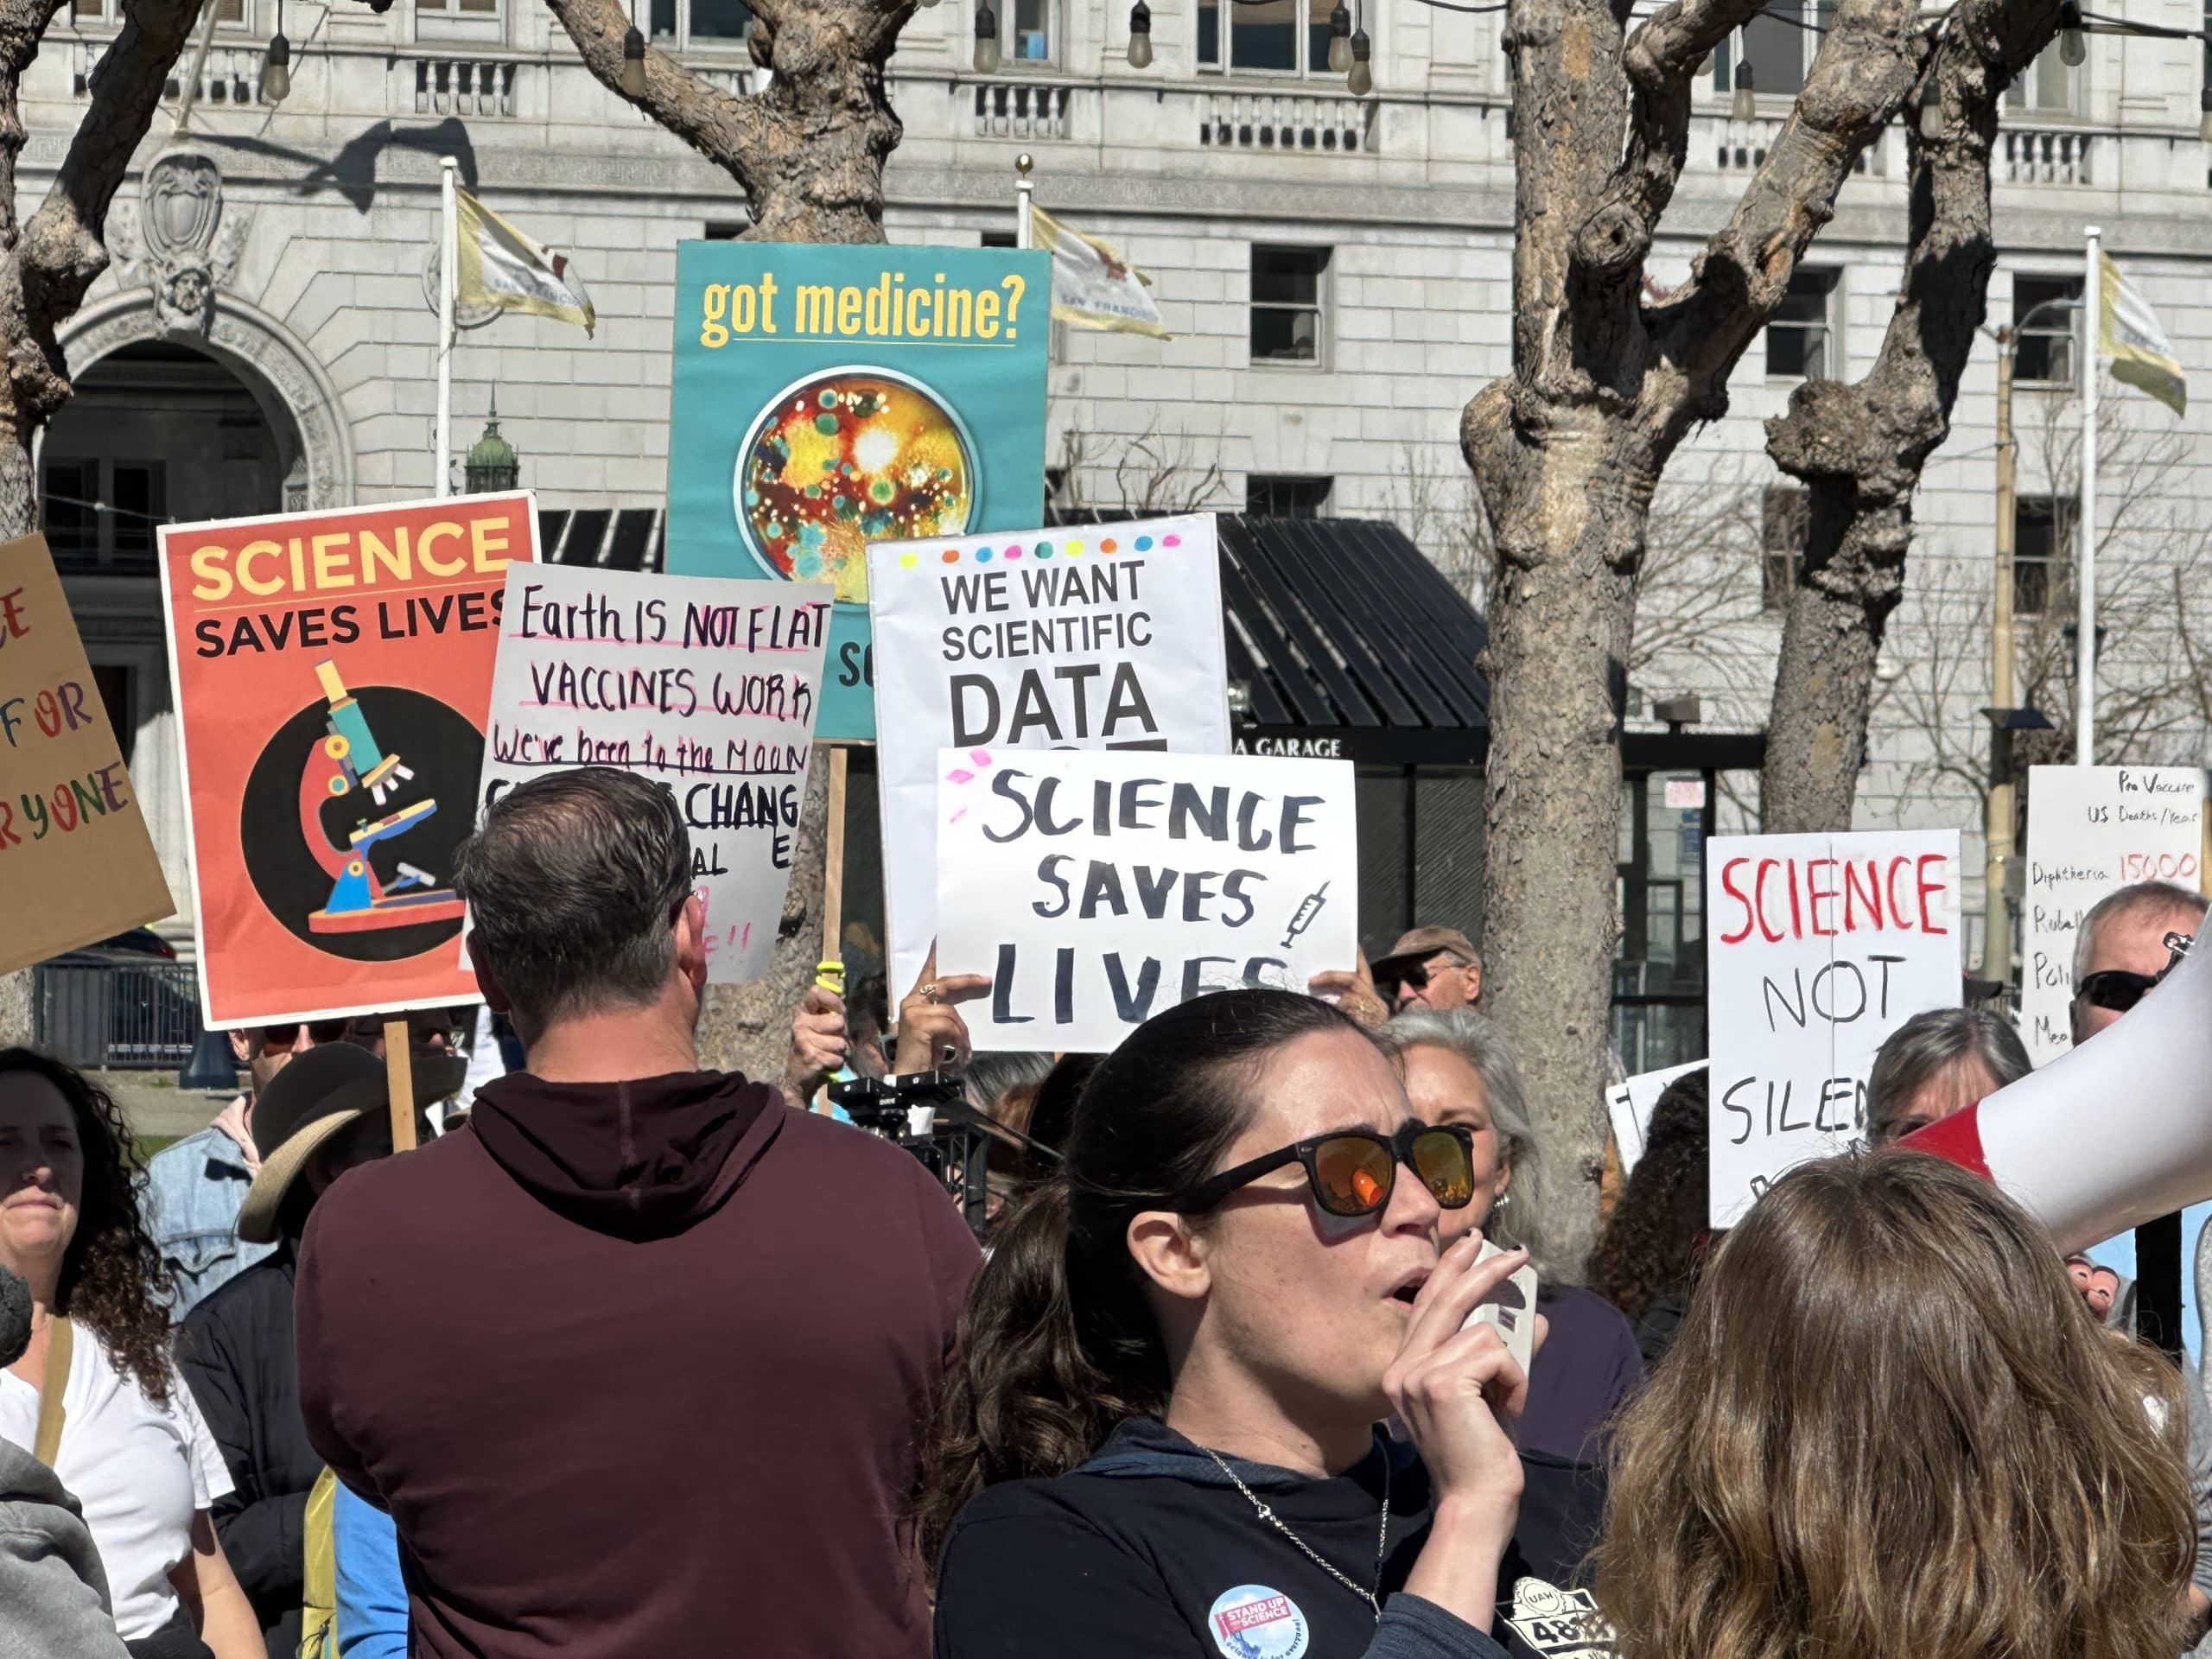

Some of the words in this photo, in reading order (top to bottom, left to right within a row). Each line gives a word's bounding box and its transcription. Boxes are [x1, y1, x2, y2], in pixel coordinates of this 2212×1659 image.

[701, 272, 778, 347] got
[796, 272, 1026, 339] medicine?
[191, 517, 512, 601] SCIENCE
[940, 570, 1009, 615] WE
[1022, 560, 1146, 607] WANT
[194, 606, 361, 658] SAVES
[522, 585, 626, 643] Earth
[636, 599, 667, 645] IS
[683, 602, 740, 649] NOT
[748, 602, 831, 653] FLAT
[942, 611, 1154, 662] SCIENTIFIC
[0, 682, 92, 748] FOR
[531, 659, 697, 717] VACCINES
[713, 671, 812, 728] WORK
[950, 661, 1159, 748] DATA
[1255, 737, 1342, 758] GARAGE
[982, 768, 1326, 855] SCIENCE
[2088, 805, 2109, 823] US
[1032, 854, 1268, 929] SAVES
[2120, 853, 2197, 880] 15000
[1720, 854, 1948, 944] SCIENCE
[1764, 955, 1907, 1033] NOT
[2034, 951, 2069, 989] Poli
[1227, 1601, 1267, 1621] STAND
[1267, 1597, 1285, 1609] UP
[1241, 1606, 1288, 1627] SCIENCE
[1528, 1591, 1554, 1604] UAW
